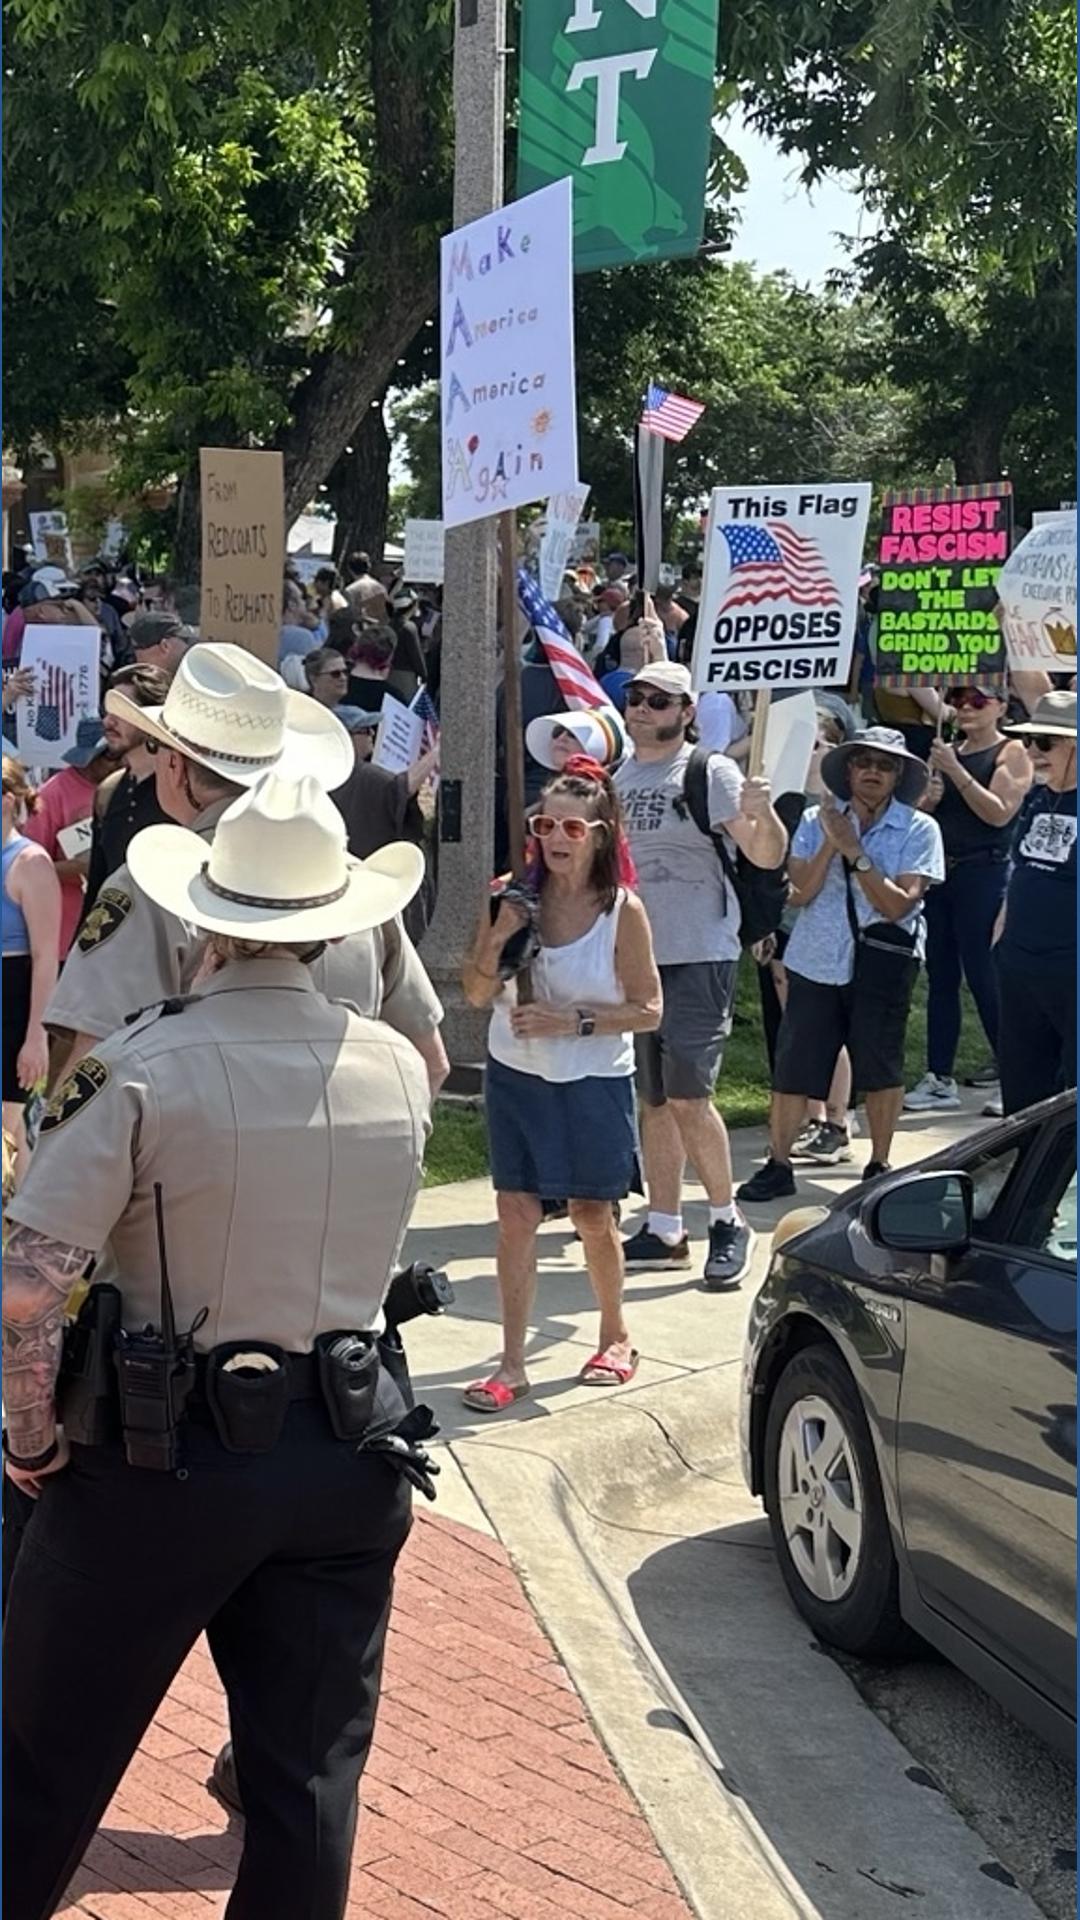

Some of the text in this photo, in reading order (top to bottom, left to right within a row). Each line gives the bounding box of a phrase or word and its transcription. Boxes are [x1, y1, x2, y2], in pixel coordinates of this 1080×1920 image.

[446, 297, 538, 357] America
[446, 371, 546, 427] America
[728, 494, 859, 519] This Flag
[892, 501, 1000, 534] RESIST
[207, 522, 267, 558] REDCOATS
[880, 532, 1007, 563] FASCISM
[882, 566, 952, 590] DON'T
[962, 568, 1001, 588] LET
[918, 590, 965, 609] THE
[713, 611, 841, 645] OPPOSES
[880, 611, 999, 631] BASTARDS
[879, 633, 999, 654] GRIND YOU
[707, 657, 838, 683] FASCISM
[902, 653, 978, 673] DOWN!
[79, 665, 89, 697] 1776
